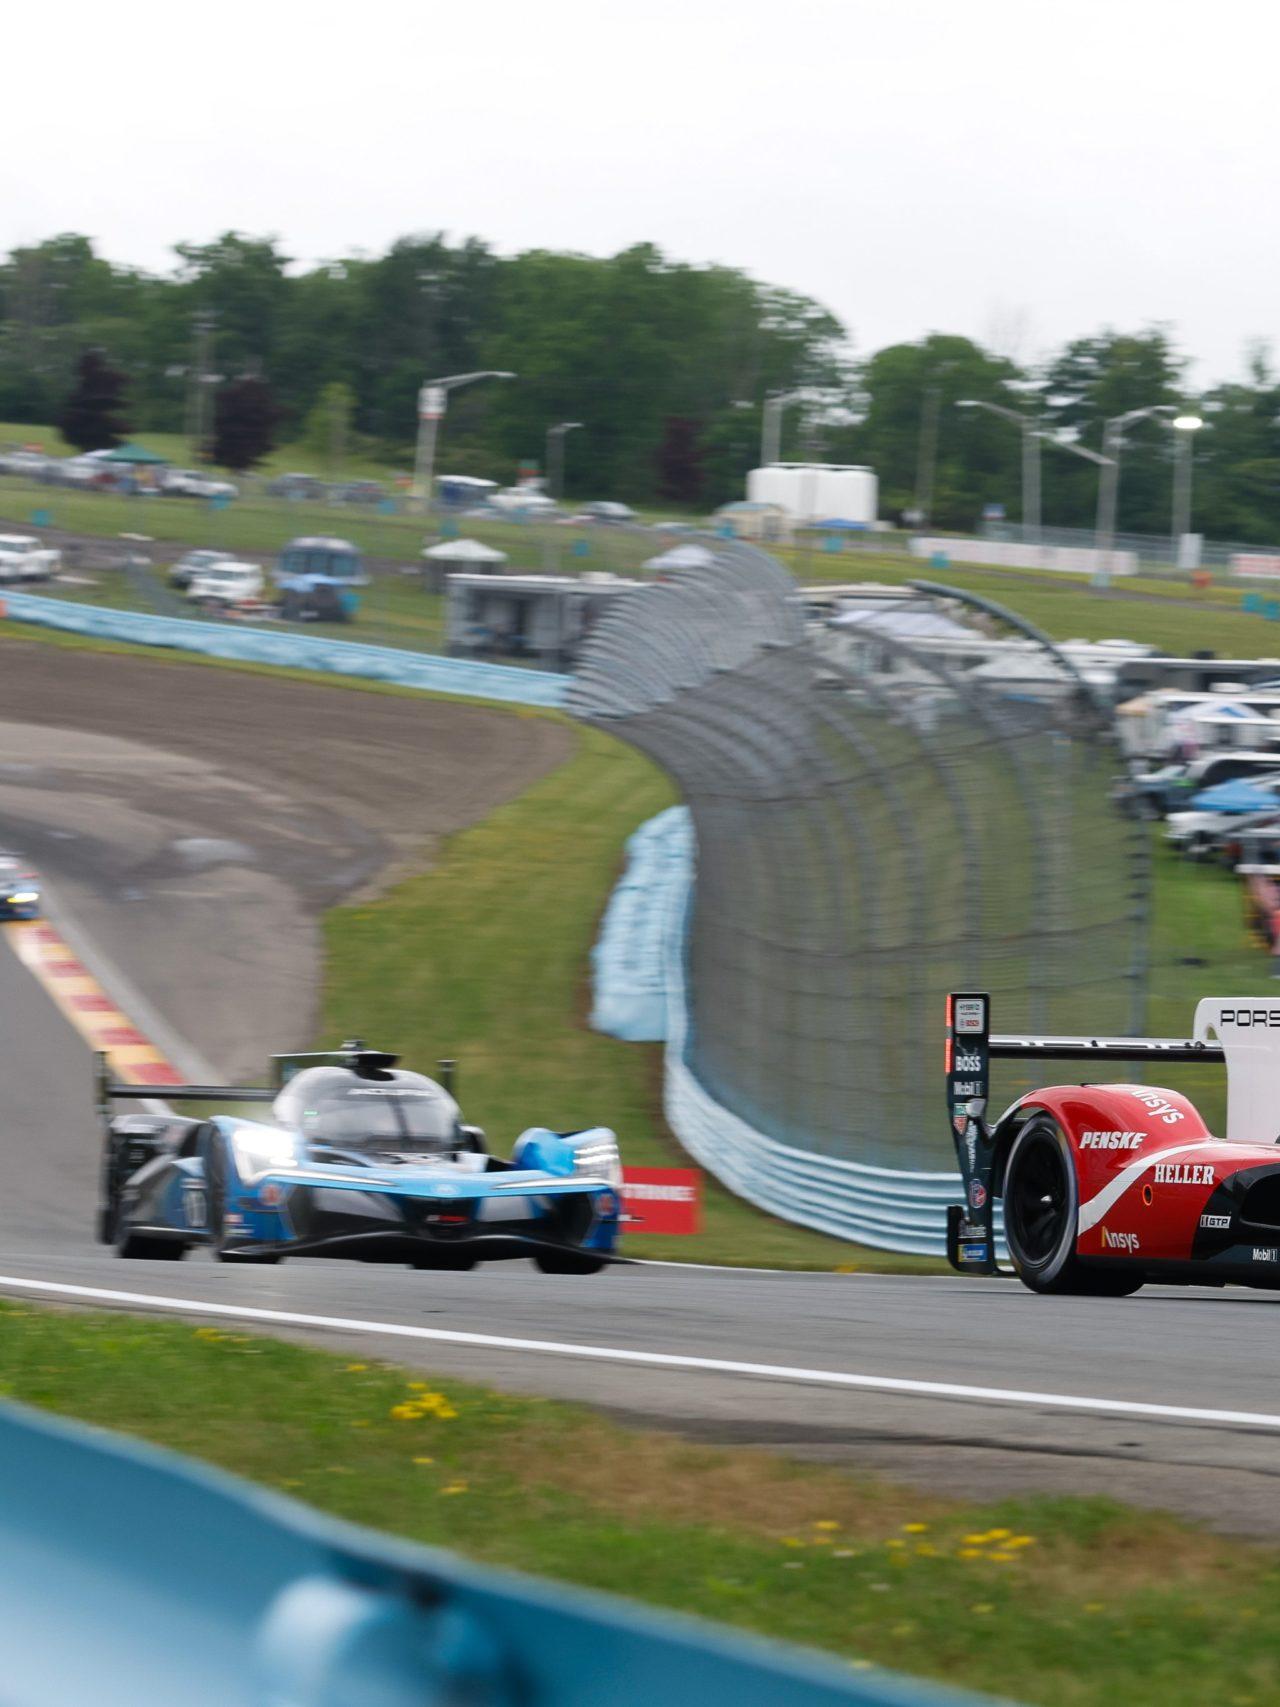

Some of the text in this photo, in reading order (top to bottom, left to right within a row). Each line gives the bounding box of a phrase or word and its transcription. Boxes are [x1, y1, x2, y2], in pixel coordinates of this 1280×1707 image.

[956, 1056, 981, 1071] BOSS
[1079, 1131, 1148, 1149] PENSKE
[1154, 1163, 1215, 1185] HELLER
[1209, 1217, 1229, 1226] GTP
[1101, 1226, 1140, 1253] Ansys
[1253, 1248, 1270, 1261] Mobil
